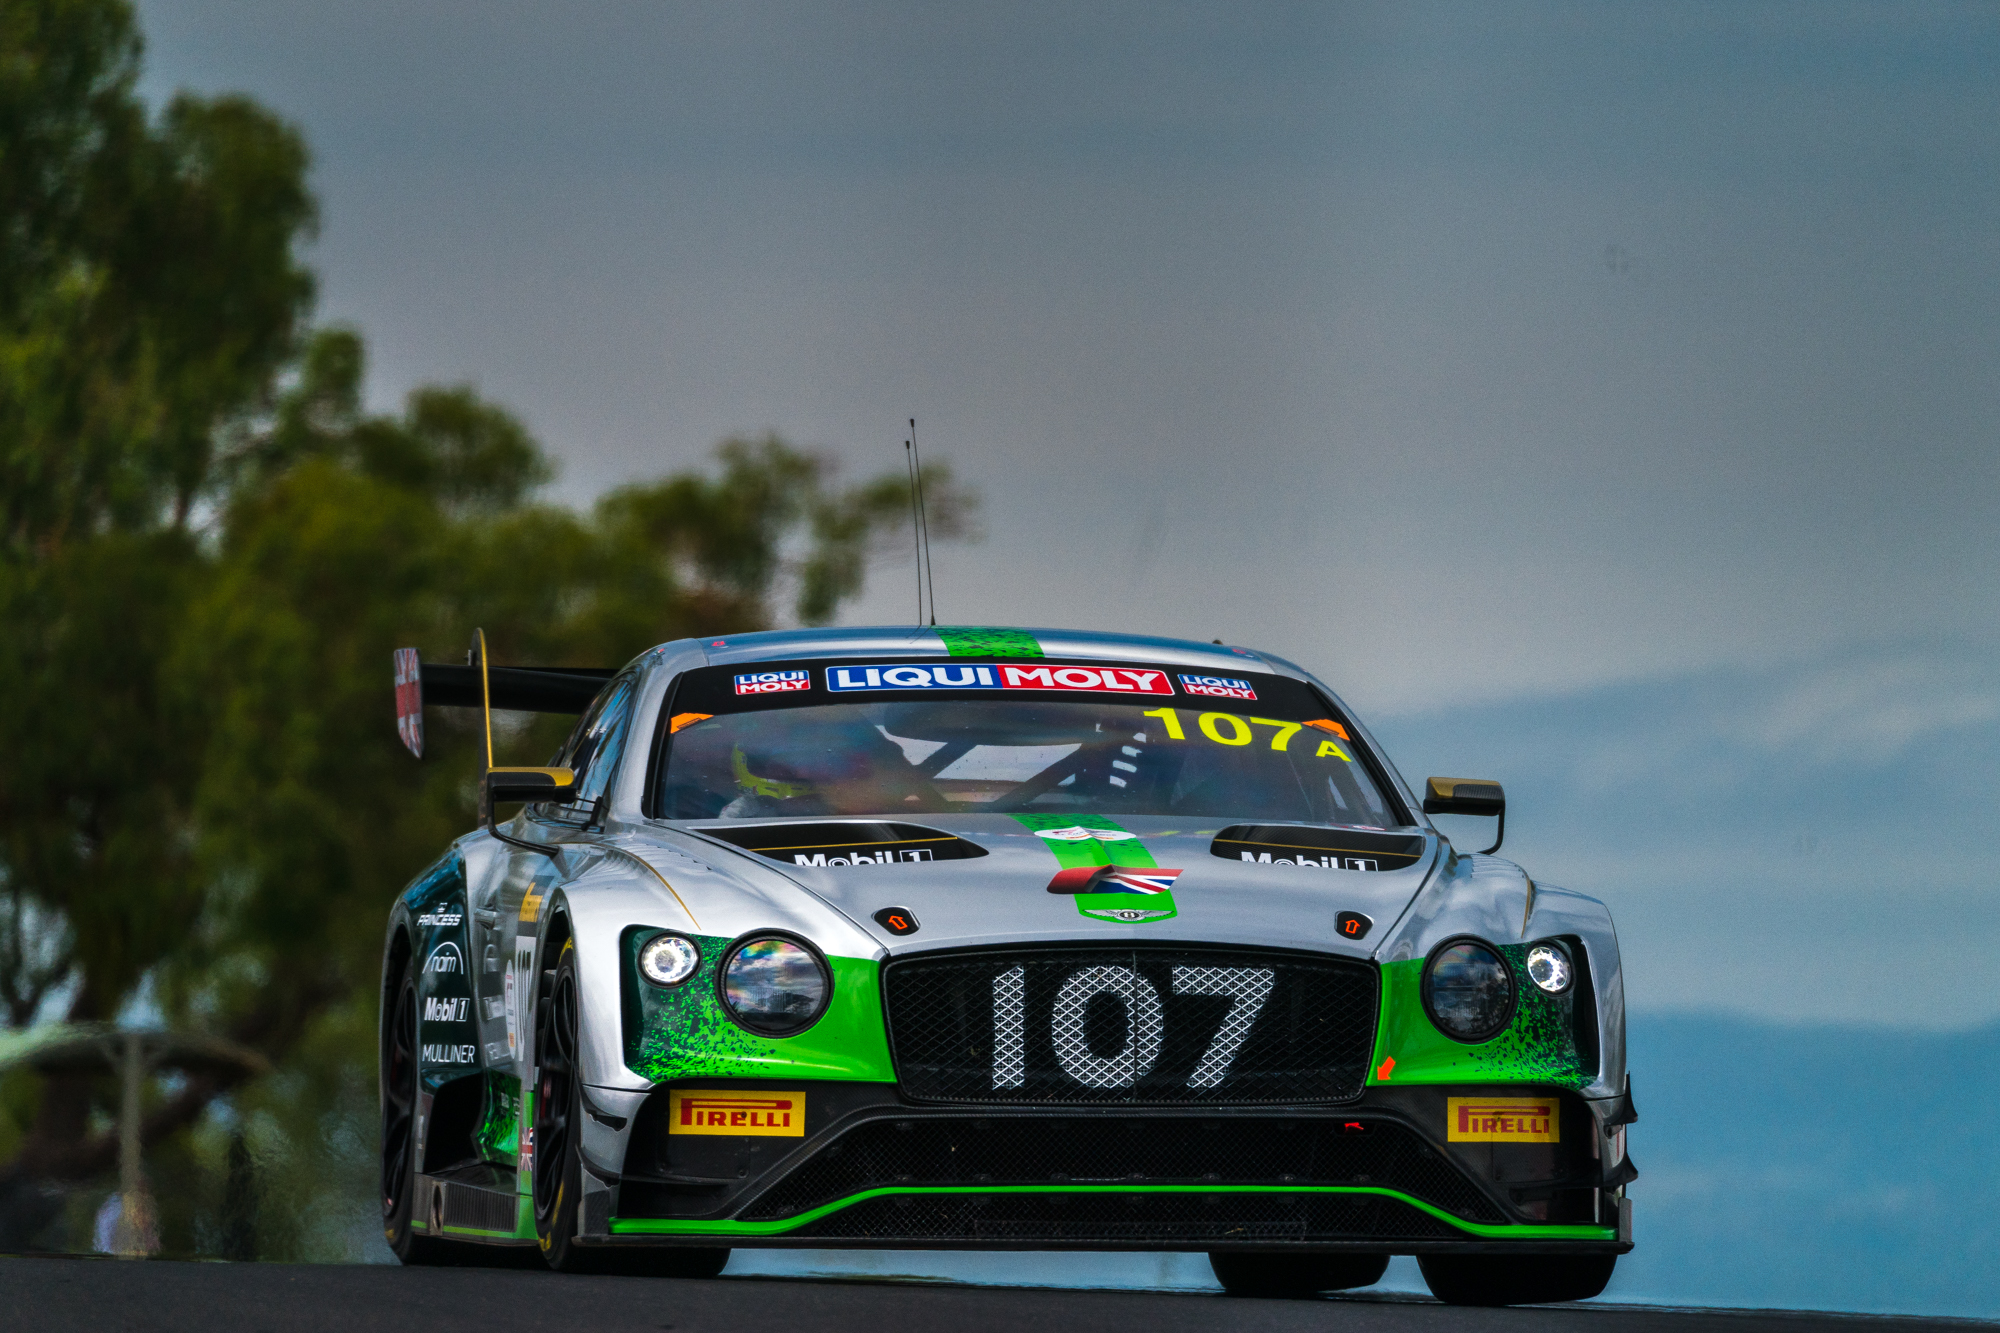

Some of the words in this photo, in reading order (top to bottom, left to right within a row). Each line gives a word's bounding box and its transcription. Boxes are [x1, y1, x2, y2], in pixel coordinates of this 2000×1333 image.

[739, 672, 804, 684] LIQUI
[739, 681, 806, 692] MOLY
[836, 667, 994, 687] LIQUI
[1004, 667, 1159, 691] MOLY
[1183, 675, 1248, 690] LIQUI
[1187, 684, 1252, 698] MOLY
[1143, 707, 1302, 752] 107
[1315, 741, 1352, 762] A
[417, 914, 462, 926] PRINCESS
[430, 952, 457, 973] naim
[424, 997, 458, 1022] Mobil
[992, 965, 1275, 1090] 107
[422, 1044, 475, 1063] MULLINER
[681, 1098, 792, 1127] PIRELLI
[1458, 1105, 1551, 1133] PIRELLI
